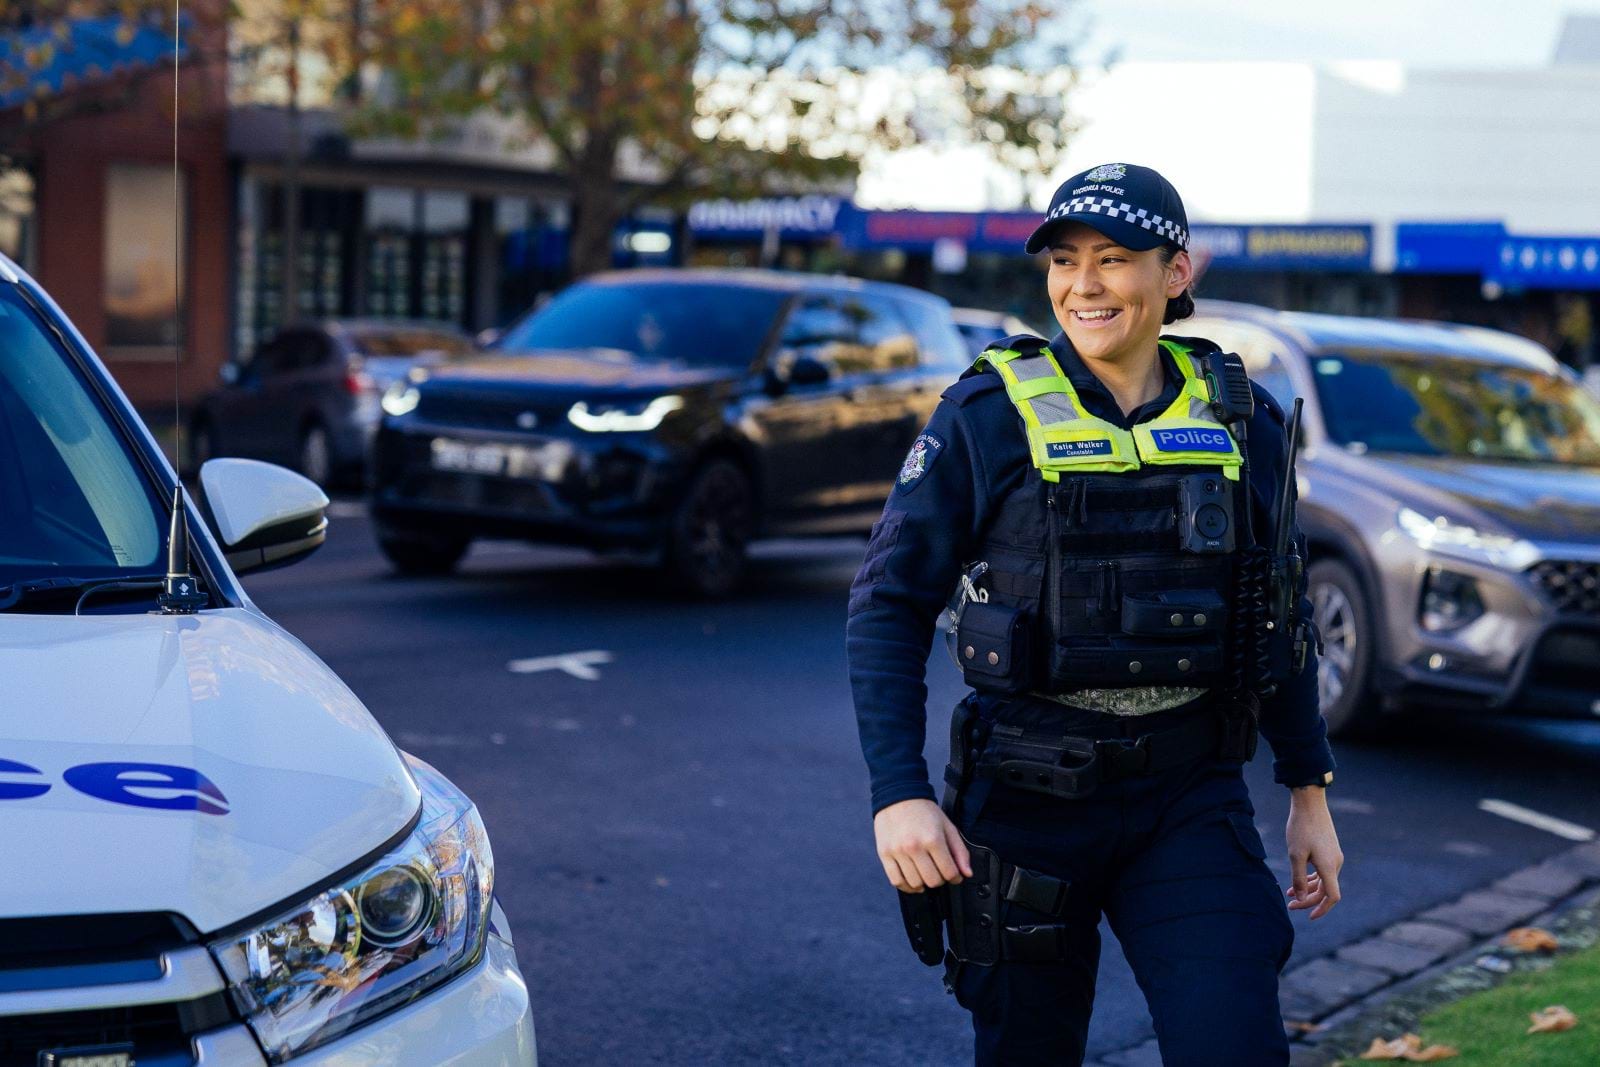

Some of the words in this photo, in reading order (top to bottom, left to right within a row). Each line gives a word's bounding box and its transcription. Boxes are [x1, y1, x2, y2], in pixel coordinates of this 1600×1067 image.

[1100, 184, 1125, 196] POLICE
[1158, 430, 1226, 446] Police
[1053, 442, 1073, 451] Katie
[1076, 441, 1104, 449] Walker
